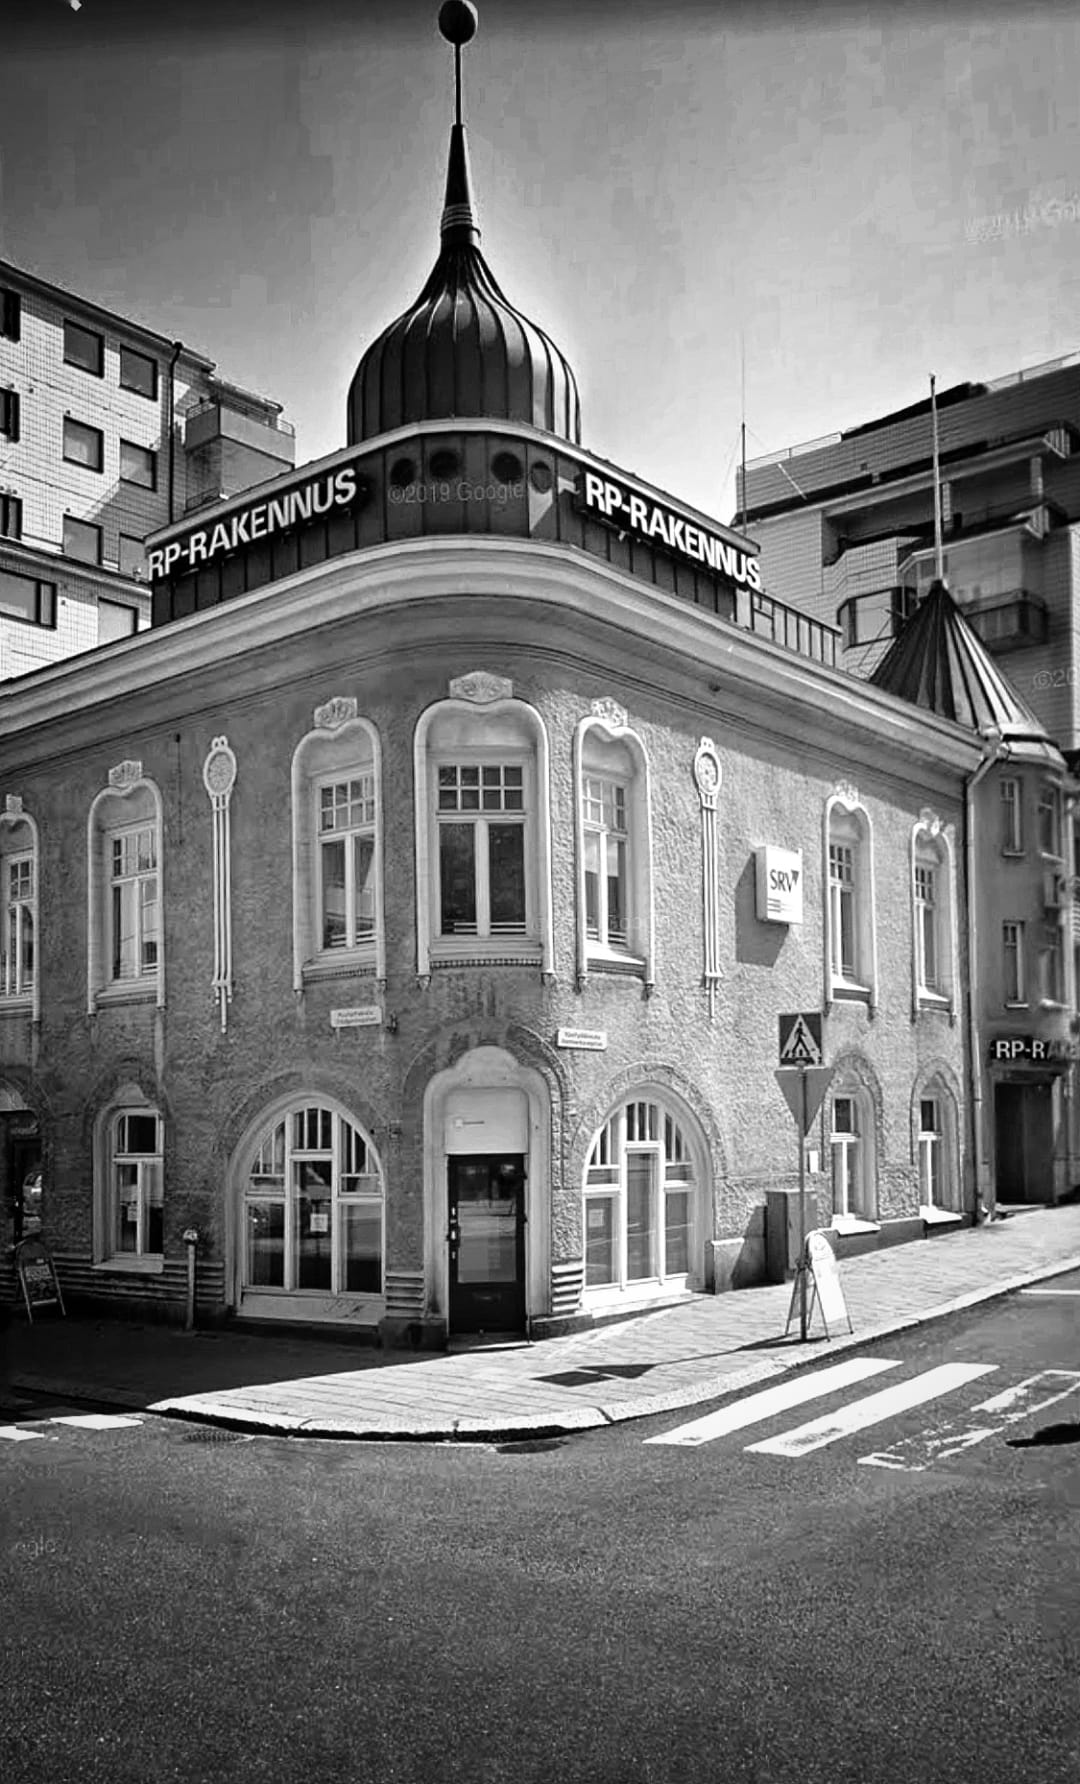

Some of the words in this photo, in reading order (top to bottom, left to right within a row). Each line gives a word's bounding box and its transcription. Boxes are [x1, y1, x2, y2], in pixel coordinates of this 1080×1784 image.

[148, 468, 356, 581] RP-RAKENNUS
[585, 472, 761, 590] RP-RAKENNUS
[769, 868, 793, 893] SRV
